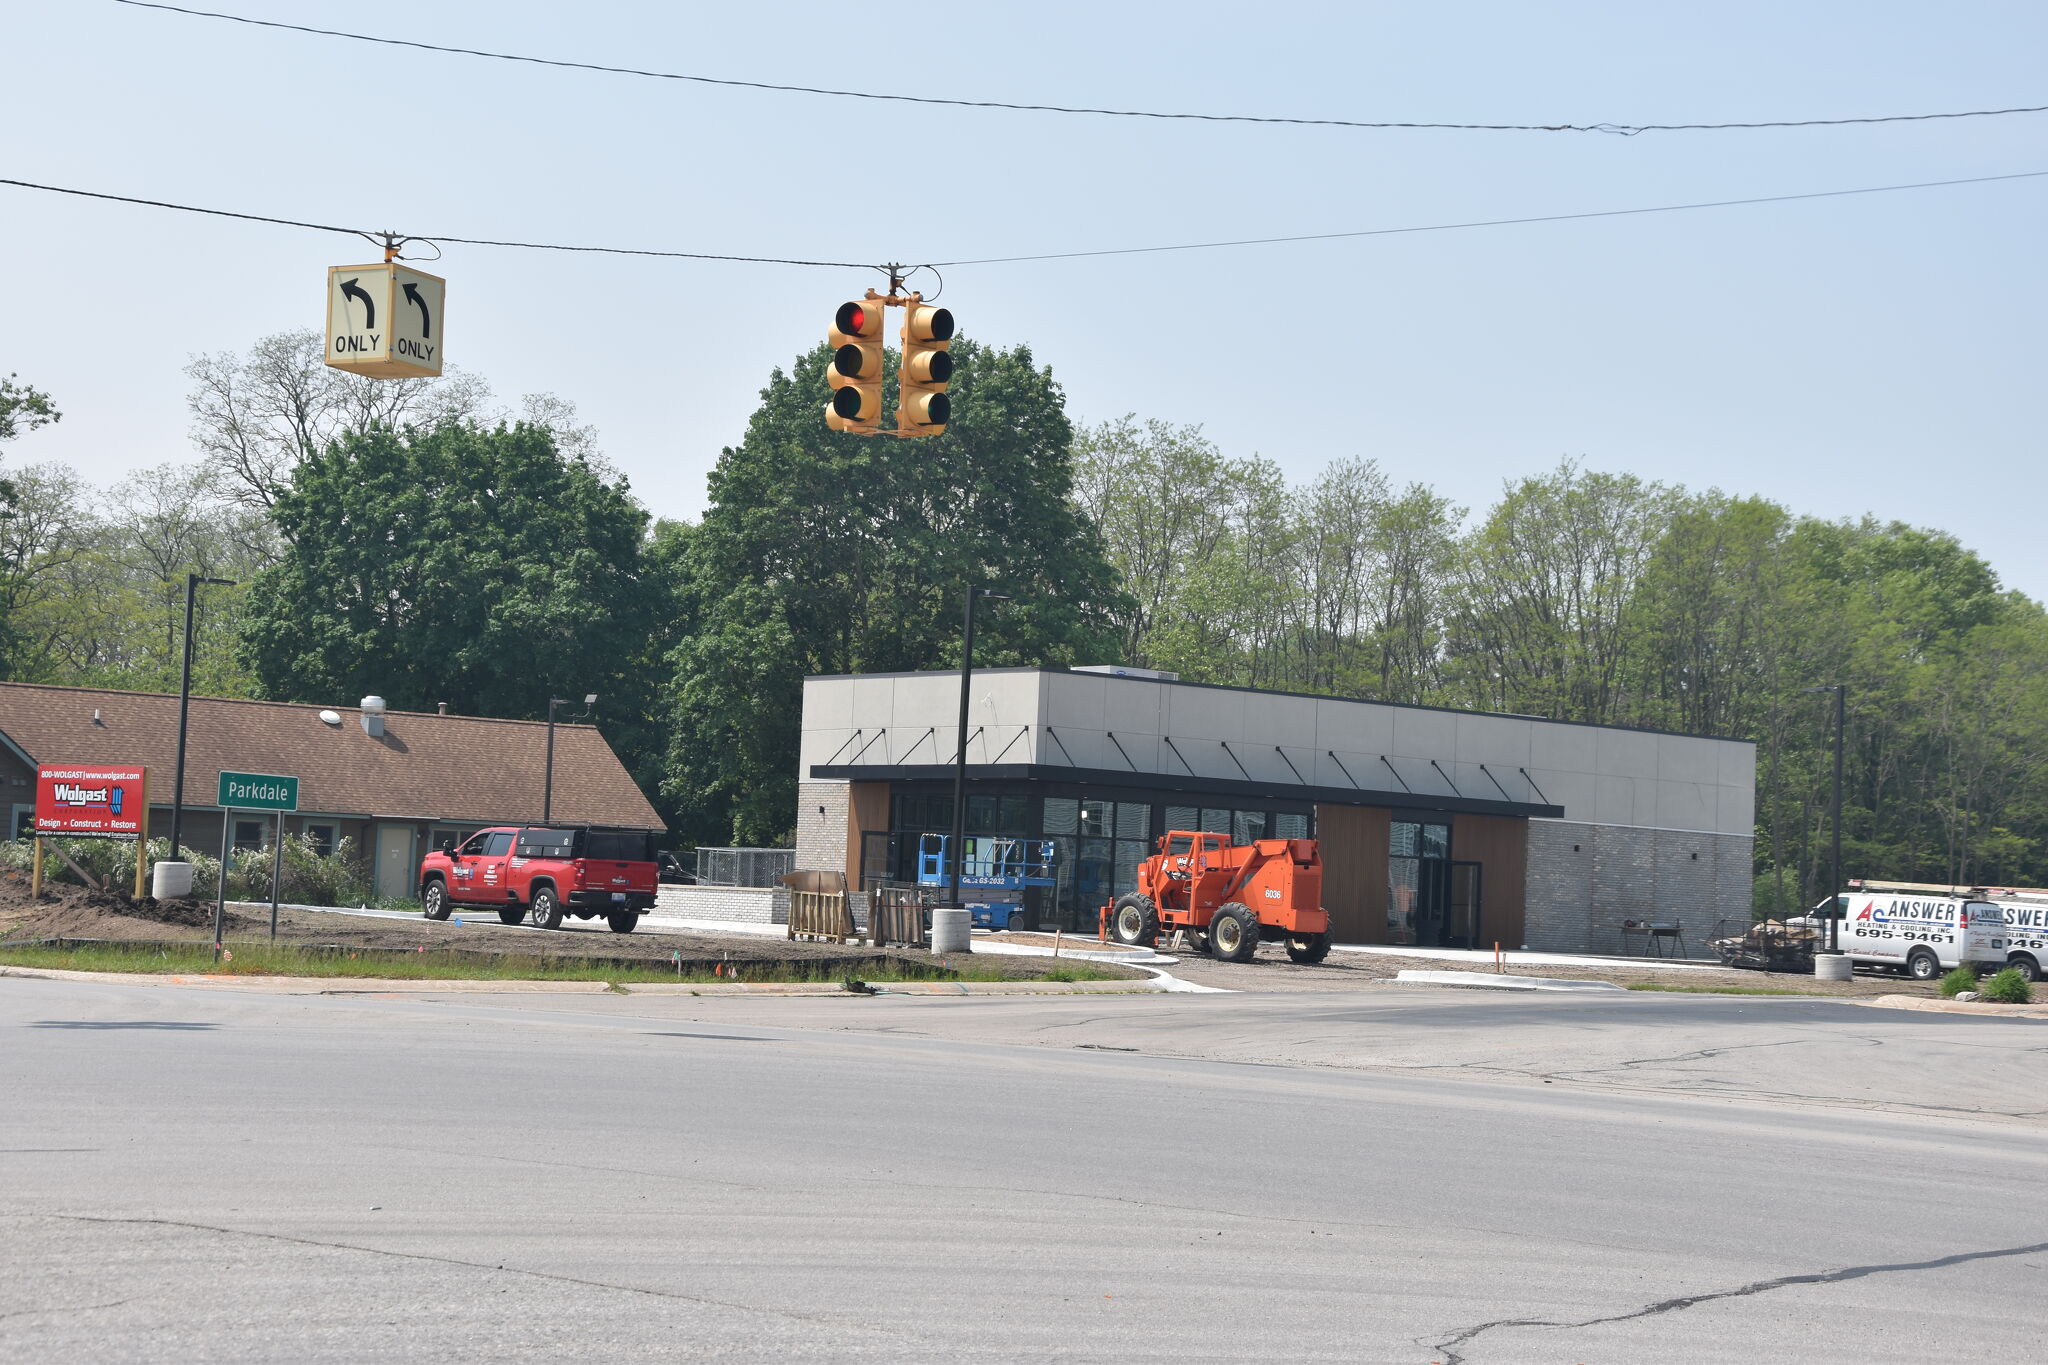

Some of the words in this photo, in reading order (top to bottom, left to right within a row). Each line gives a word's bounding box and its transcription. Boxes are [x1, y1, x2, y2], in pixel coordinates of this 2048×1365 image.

[335, 334, 380, 353] ONLY
[398, 338, 434, 362] ONLY
[53, 783, 108, 806] Wolgast
[229, 782, 288, 801] Parkdale
[39, 818, 61, 829] Design
[70, 819, 102, 828] Construct
[110, 820, 137, 829] Restore
[1265, 889, 1281, 899] 6036
[1888, 900, 1955, 921] ANSWER
[1856, 928, 1954, 944] 695-9461
